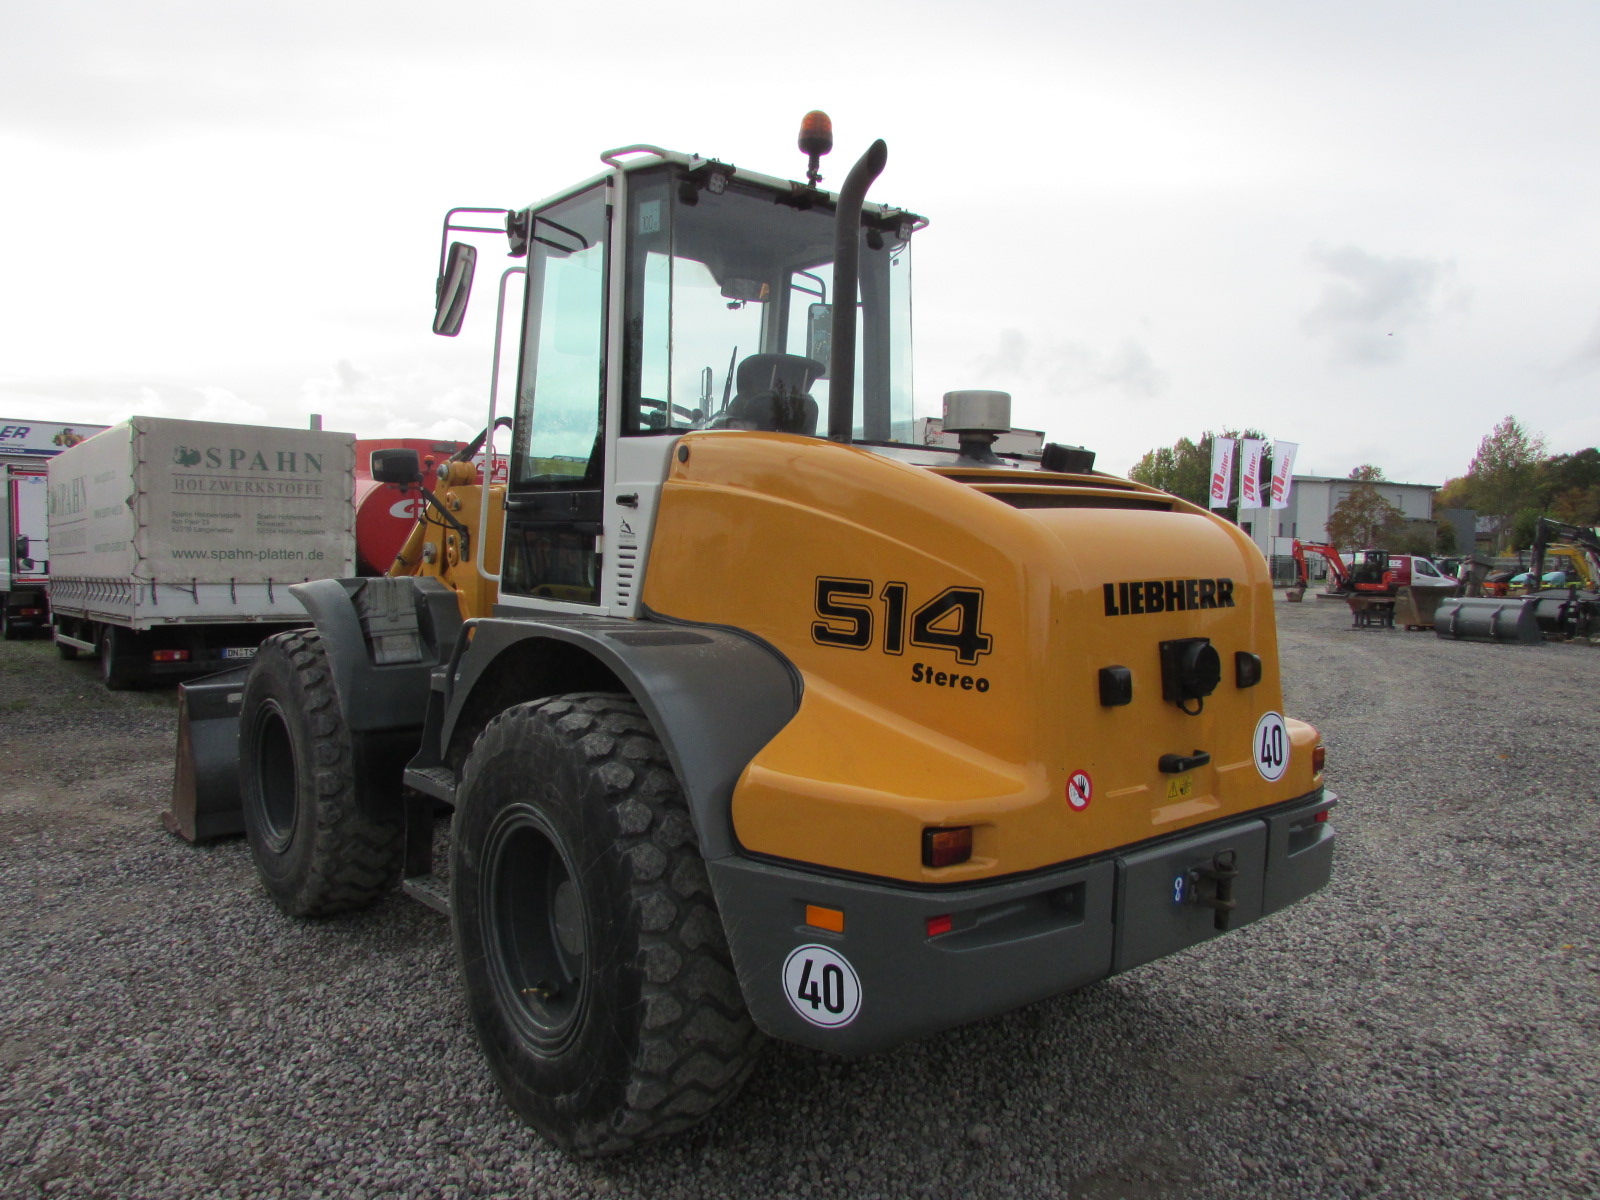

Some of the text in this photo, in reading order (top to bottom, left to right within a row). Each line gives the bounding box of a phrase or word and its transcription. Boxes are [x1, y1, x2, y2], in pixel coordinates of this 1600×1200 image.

[206, 447, 324, 473] SPAHN
[174, 478, 323, 495] HOLZWERKSTOFFE
[172, 547, 324, 562] www.spahn-platten.de
[1103, 577, 1235, 617] LIEBHERR
[811, 575, 993, 667] 514
[911, 663, 990, 693] Stereo
[1261, 724, 1284, 768] 40
[797, 958, 845, 1014] 40
